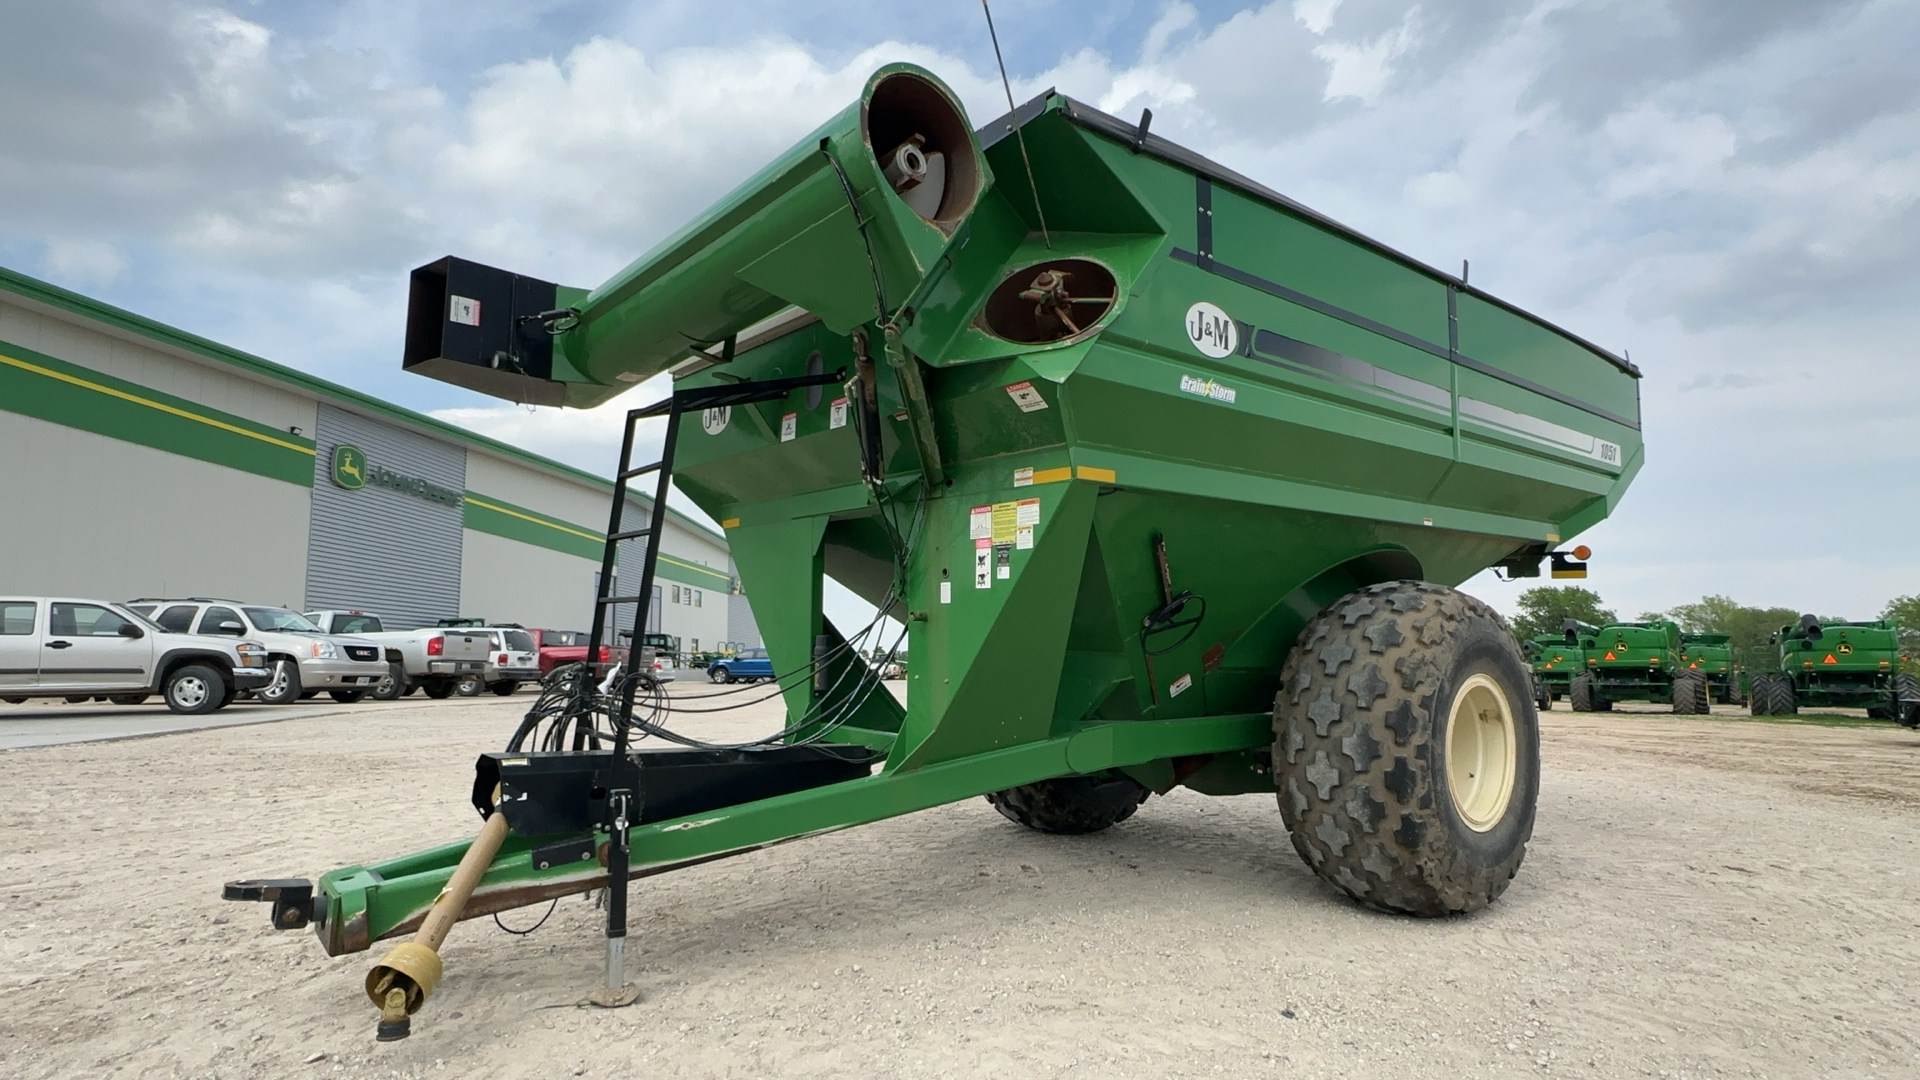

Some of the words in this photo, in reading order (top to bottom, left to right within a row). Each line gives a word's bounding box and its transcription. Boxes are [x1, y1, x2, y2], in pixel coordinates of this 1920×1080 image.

[1190, 310, 1230, 351] J&M
[1180, 375, 1206, 396] Grain
[1209, 382, 1236, 403] Storm
[704, 405, 727, 430] J&M
[1600, 443, 1617, 462] 1051
